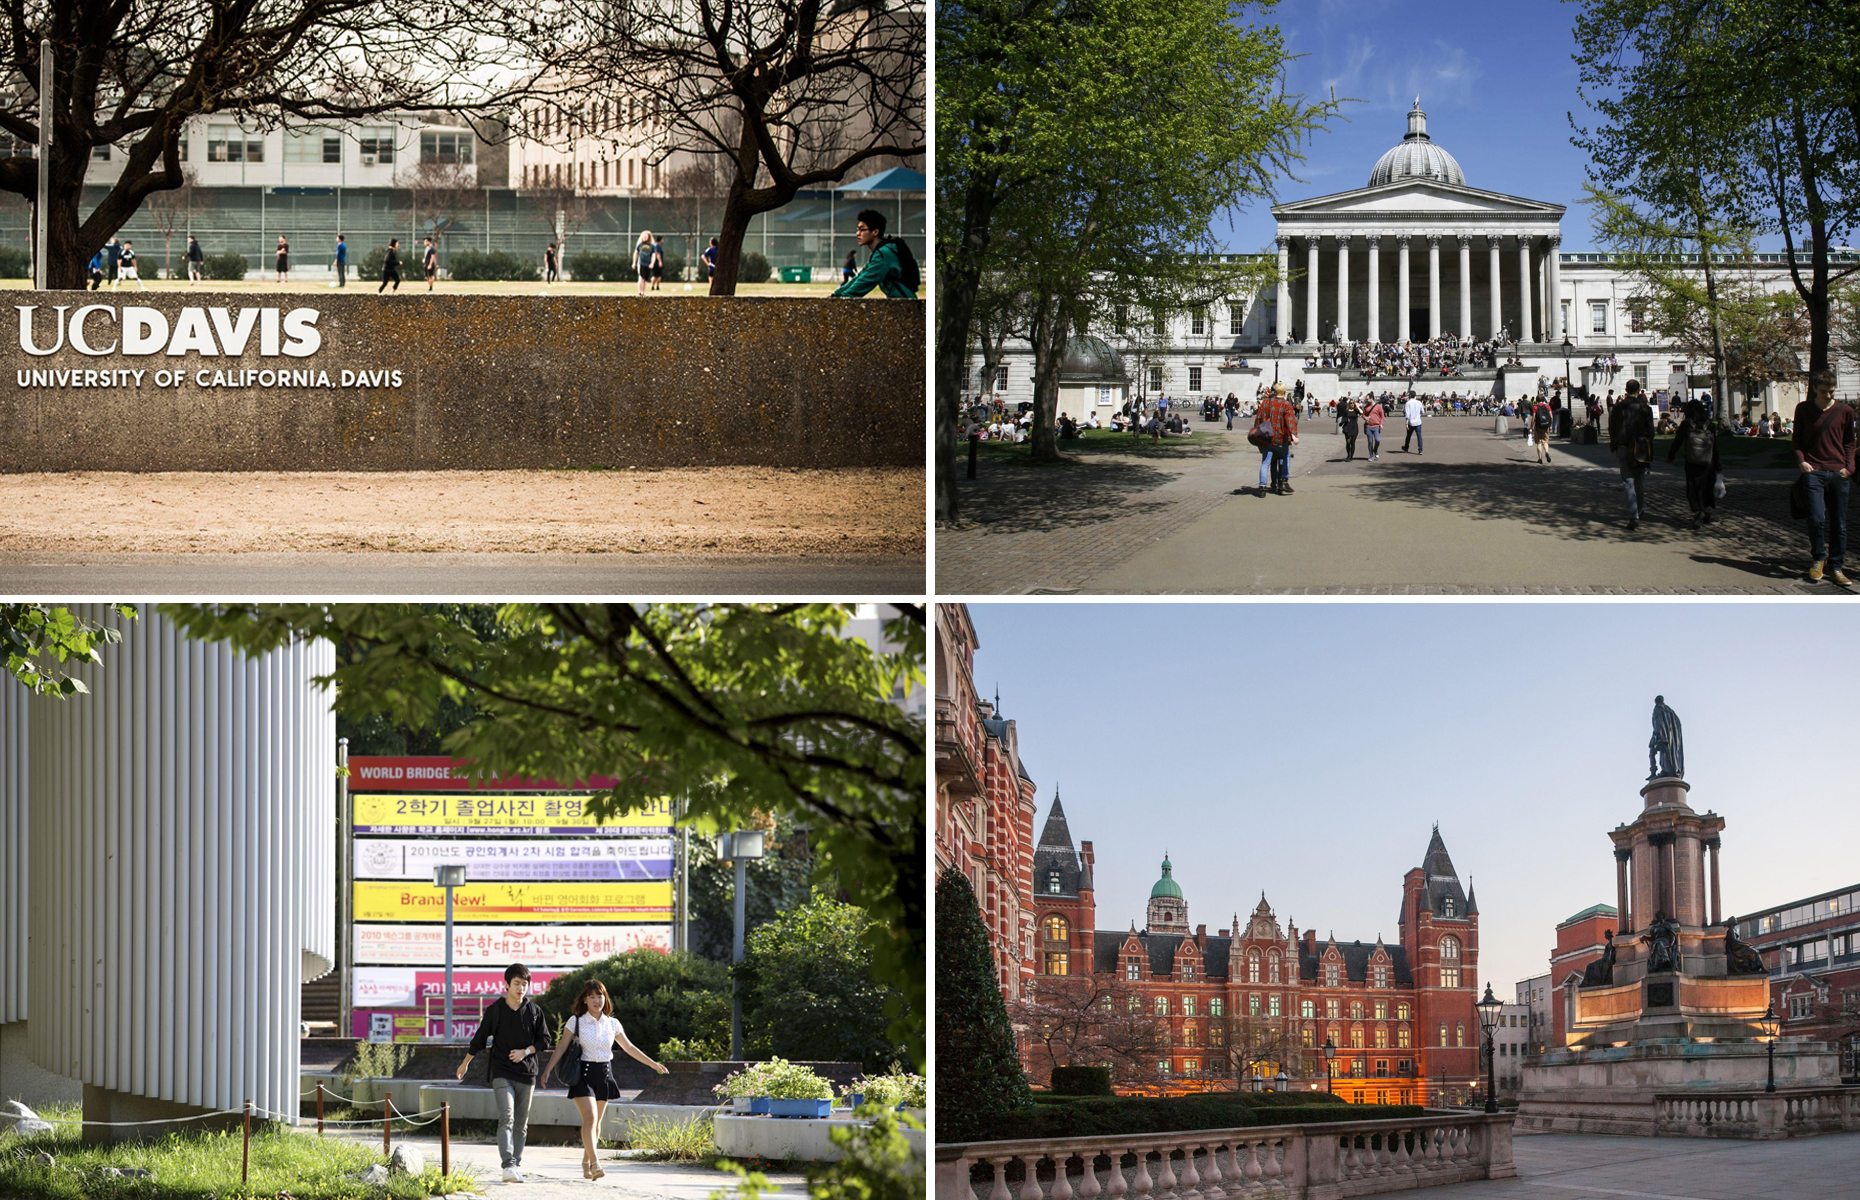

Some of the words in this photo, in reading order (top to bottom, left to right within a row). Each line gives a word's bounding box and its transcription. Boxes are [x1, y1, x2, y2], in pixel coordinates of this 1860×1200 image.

[16, 369, 145, 388] UNIVERSITY
[154, 369, 184, 388] OF
[196, 369, 336, 390] CALIFORNIA,
[341, 369, 403, 388] DAVIS
[360, 767, 403, 779] WORLD
[406, 767, 450, 779] BRIDGE
[396, 799, 446, 816] 2학기
[456, 799, 534, 817] 졸업사진
[544, 799, 582, 818] 촬영
[411, 847, 460, 857] 2010년도
[465, 847, 518, 857] 공인회계사
[523, 847, 541, 857] 2차
[545, 847, 566, 857] 시험
[401, 892, 444, 905] Brand
[452, 893, 486, 906] New!
[557, 894, 600, 905] 영어회화
[603, 894, 646, 905] 프로그램
[361, 931, 381, 940] 2010
[577, 936, 616, 958] 항해!
